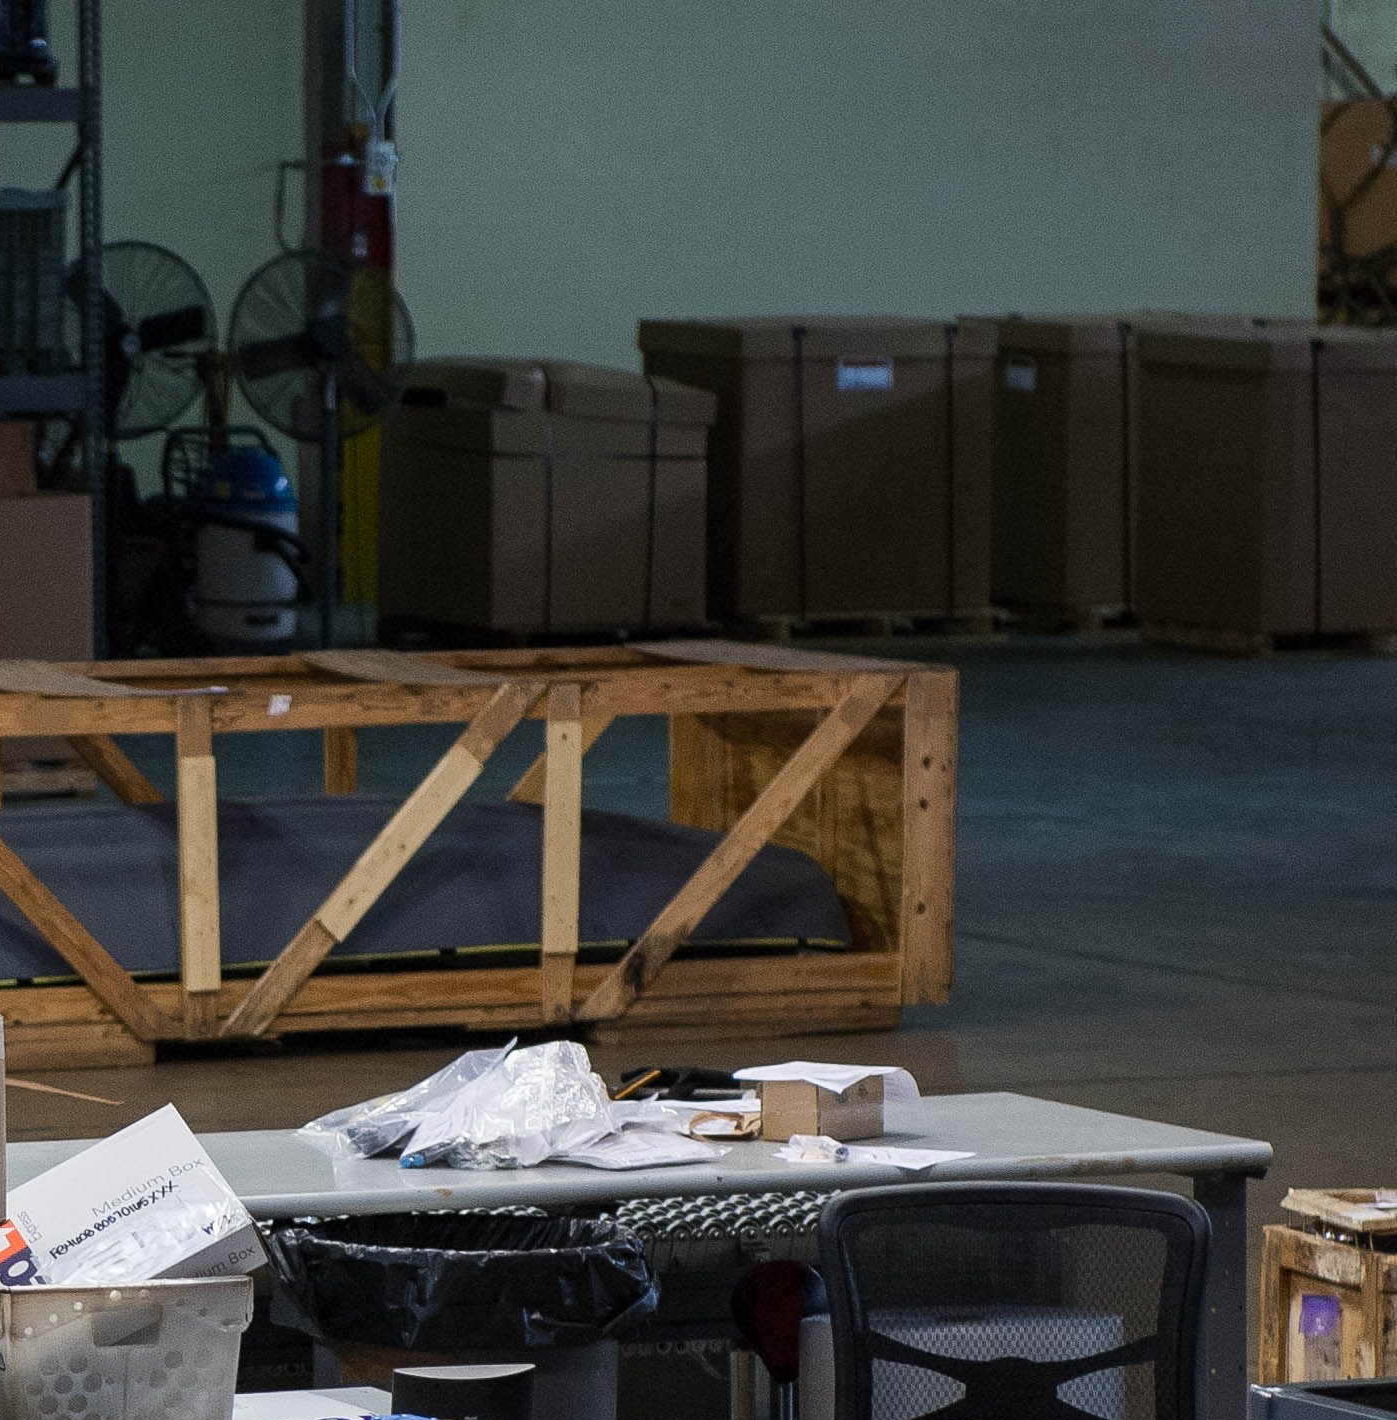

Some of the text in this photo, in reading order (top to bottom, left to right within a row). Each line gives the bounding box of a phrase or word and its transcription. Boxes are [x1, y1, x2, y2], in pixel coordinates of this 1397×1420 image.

[92, 1157, 206, 1218] Medium Box
[228, 1247, 255, 1265] Box
